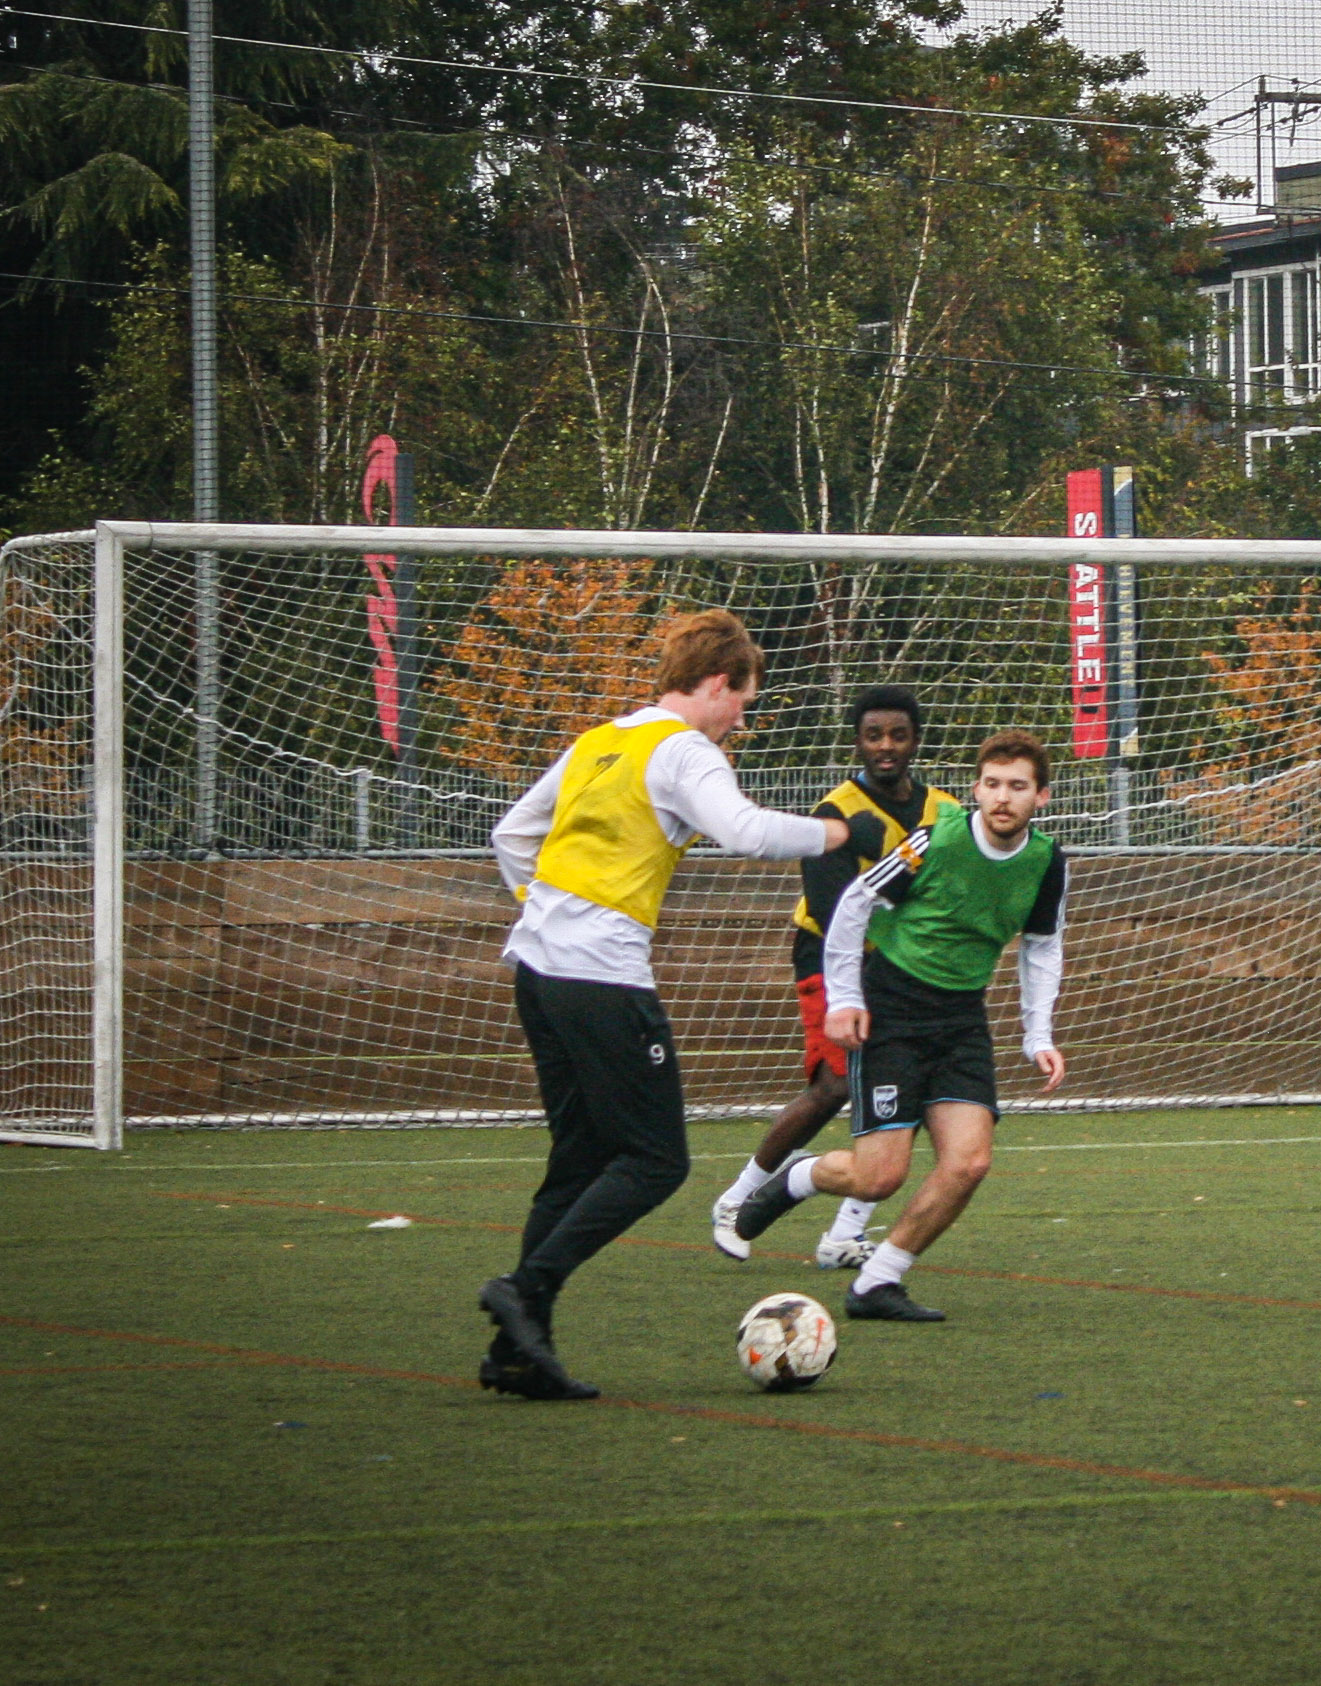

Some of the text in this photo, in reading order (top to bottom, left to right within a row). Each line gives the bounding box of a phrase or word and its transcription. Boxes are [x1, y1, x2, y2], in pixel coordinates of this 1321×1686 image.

[1074, 511, 1101, 682] SATTLE
[1118, 534, 1136, 687] HIEVEMENT
[649, 1043, 665, 1065] 9
